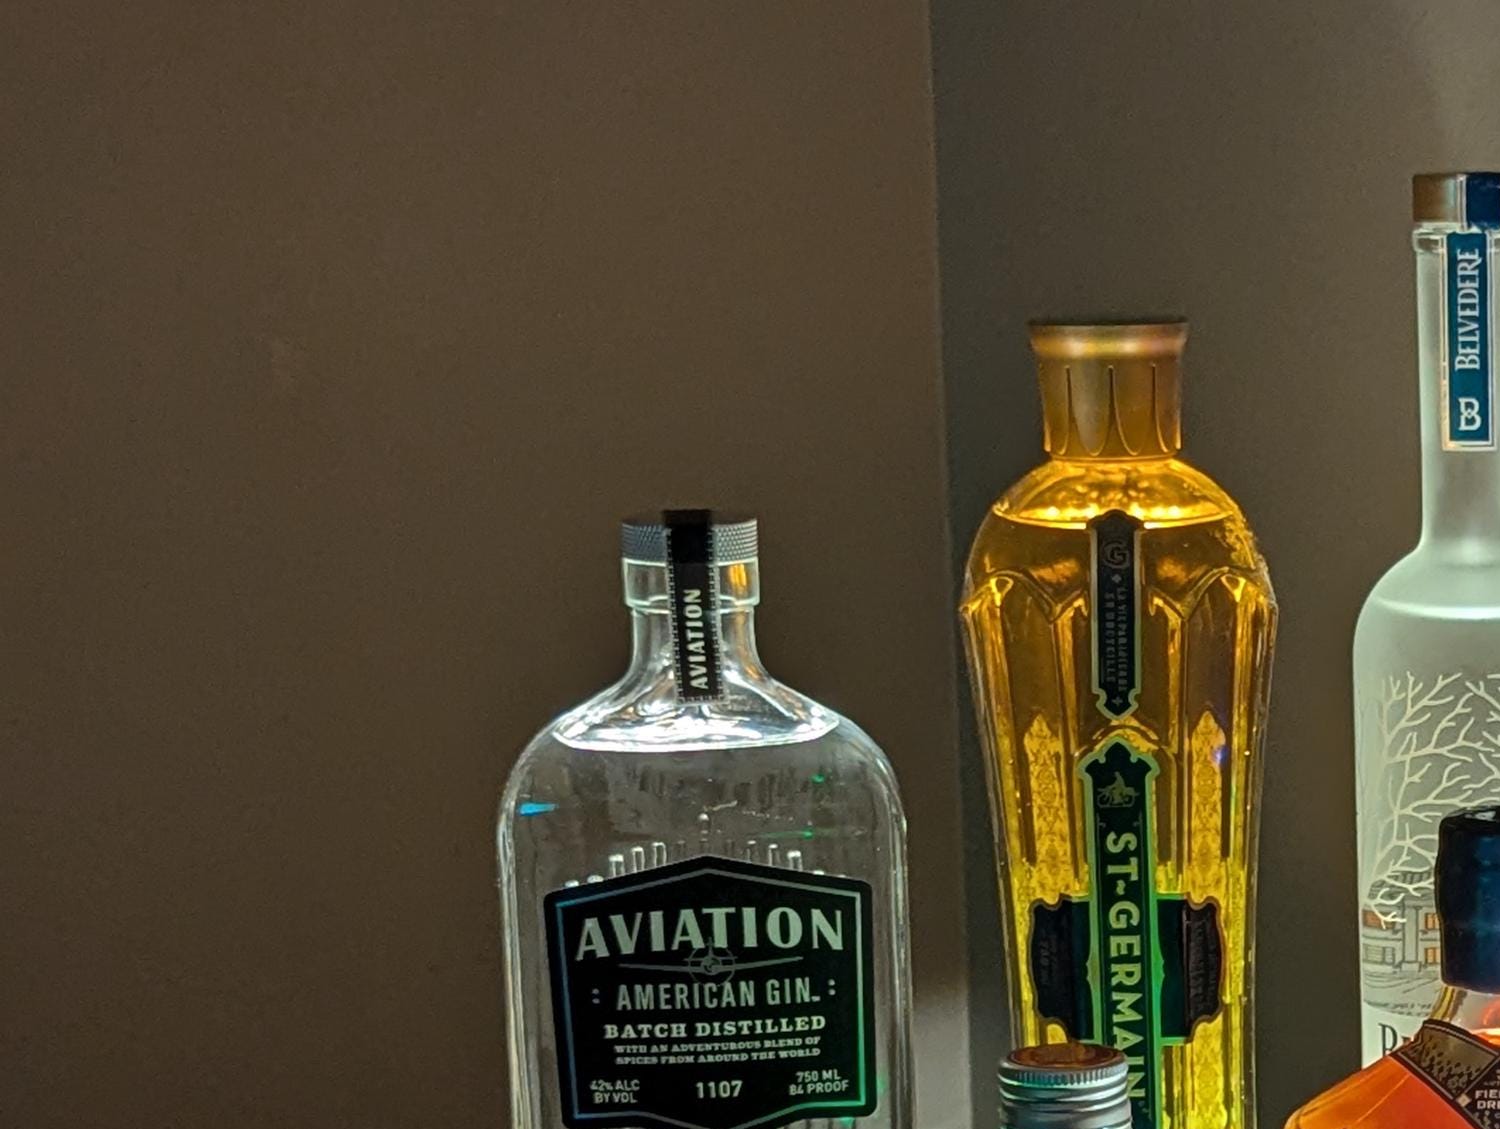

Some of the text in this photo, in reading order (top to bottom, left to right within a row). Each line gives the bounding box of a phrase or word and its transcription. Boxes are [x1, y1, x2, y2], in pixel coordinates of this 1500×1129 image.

[1455, 248, 1482, 370] BELVEDERE
[1458, 397, 1482, 431] B
[683, 589, 709, 690] AVIATION
[576, 907, 843, 961] AVIATION
[617, 977, 811, 1010] AMERICAN GIN
[604, 1016, 826, 1039] BATCH DISTILLED
[614, 1036, 821, 1054] WITH AN ADVENTUROUS BLEND OF
[616, 1047, 821, 1065] SPICES FROM AROUND THE WORLD
[796, 1069, 841, 1082] 750 ML
[616, 1080, 640, 1091] ALC
[696, 1080, 743, 1099] 1107
[789, 1080, 849, 1096] 84 PROOF
[593, 1092, 637, 1104] BY VOL
